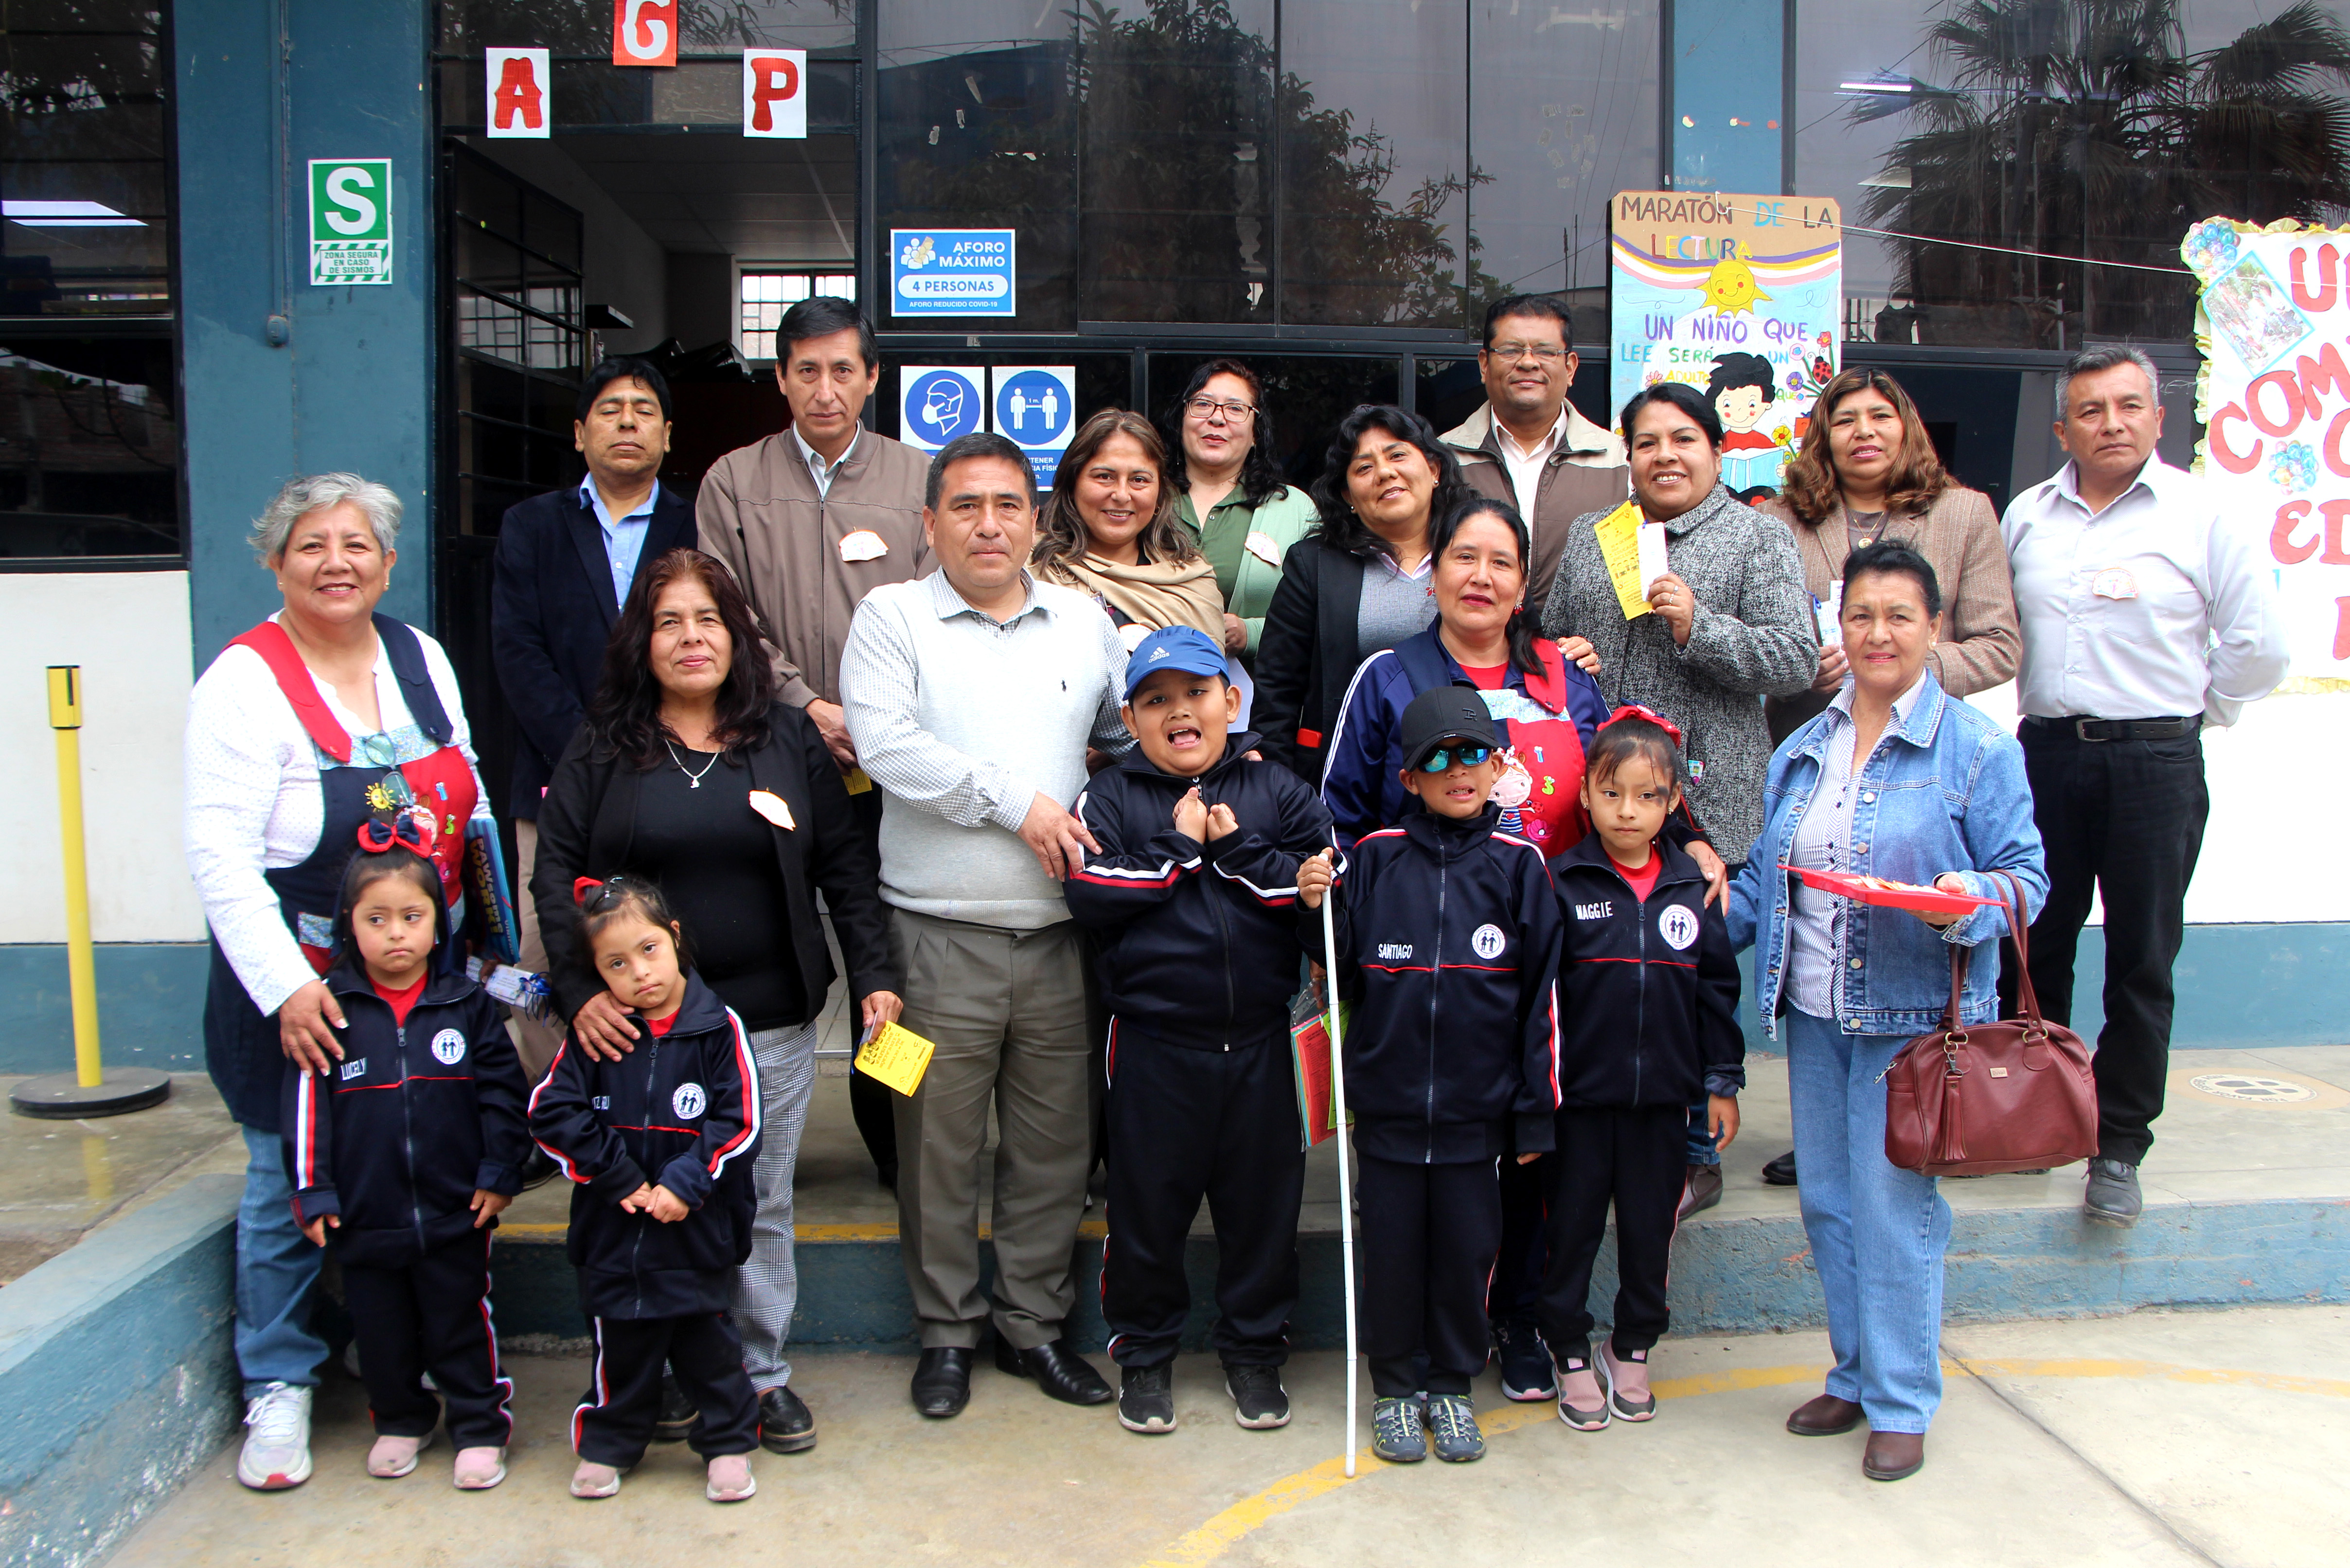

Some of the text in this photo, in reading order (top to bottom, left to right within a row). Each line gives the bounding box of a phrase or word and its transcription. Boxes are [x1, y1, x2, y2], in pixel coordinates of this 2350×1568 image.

[621, 0, 671, 59] G
[494, 57, 543, 129] A
[751, 57, 799, 132] P
[324, 167, 376, 235] S
[1621, 196, 1834, 229] MARATÓN DE LA
[953, 242, 1005, 253] AFORO
[1651, 234, 1753, 260] LECTURA
[939, 252, 1005, 267] MÁXIMO
[912, 281, 994, 291] 4 PERSONAS
[1645, 314, 1808, 345] UN NIÑO QUE
[1621, 342, 1788, 364] LEE SERÁ UN
[1776, 388, 1797, 403] QUE
[1148, 652, 1170, 663] adidas
[469, 839, 498, 933] WORK!
[1575, 901, 1614, 920] MAGGIE
[1378, 944, 1413, 960] SANTIAGO
